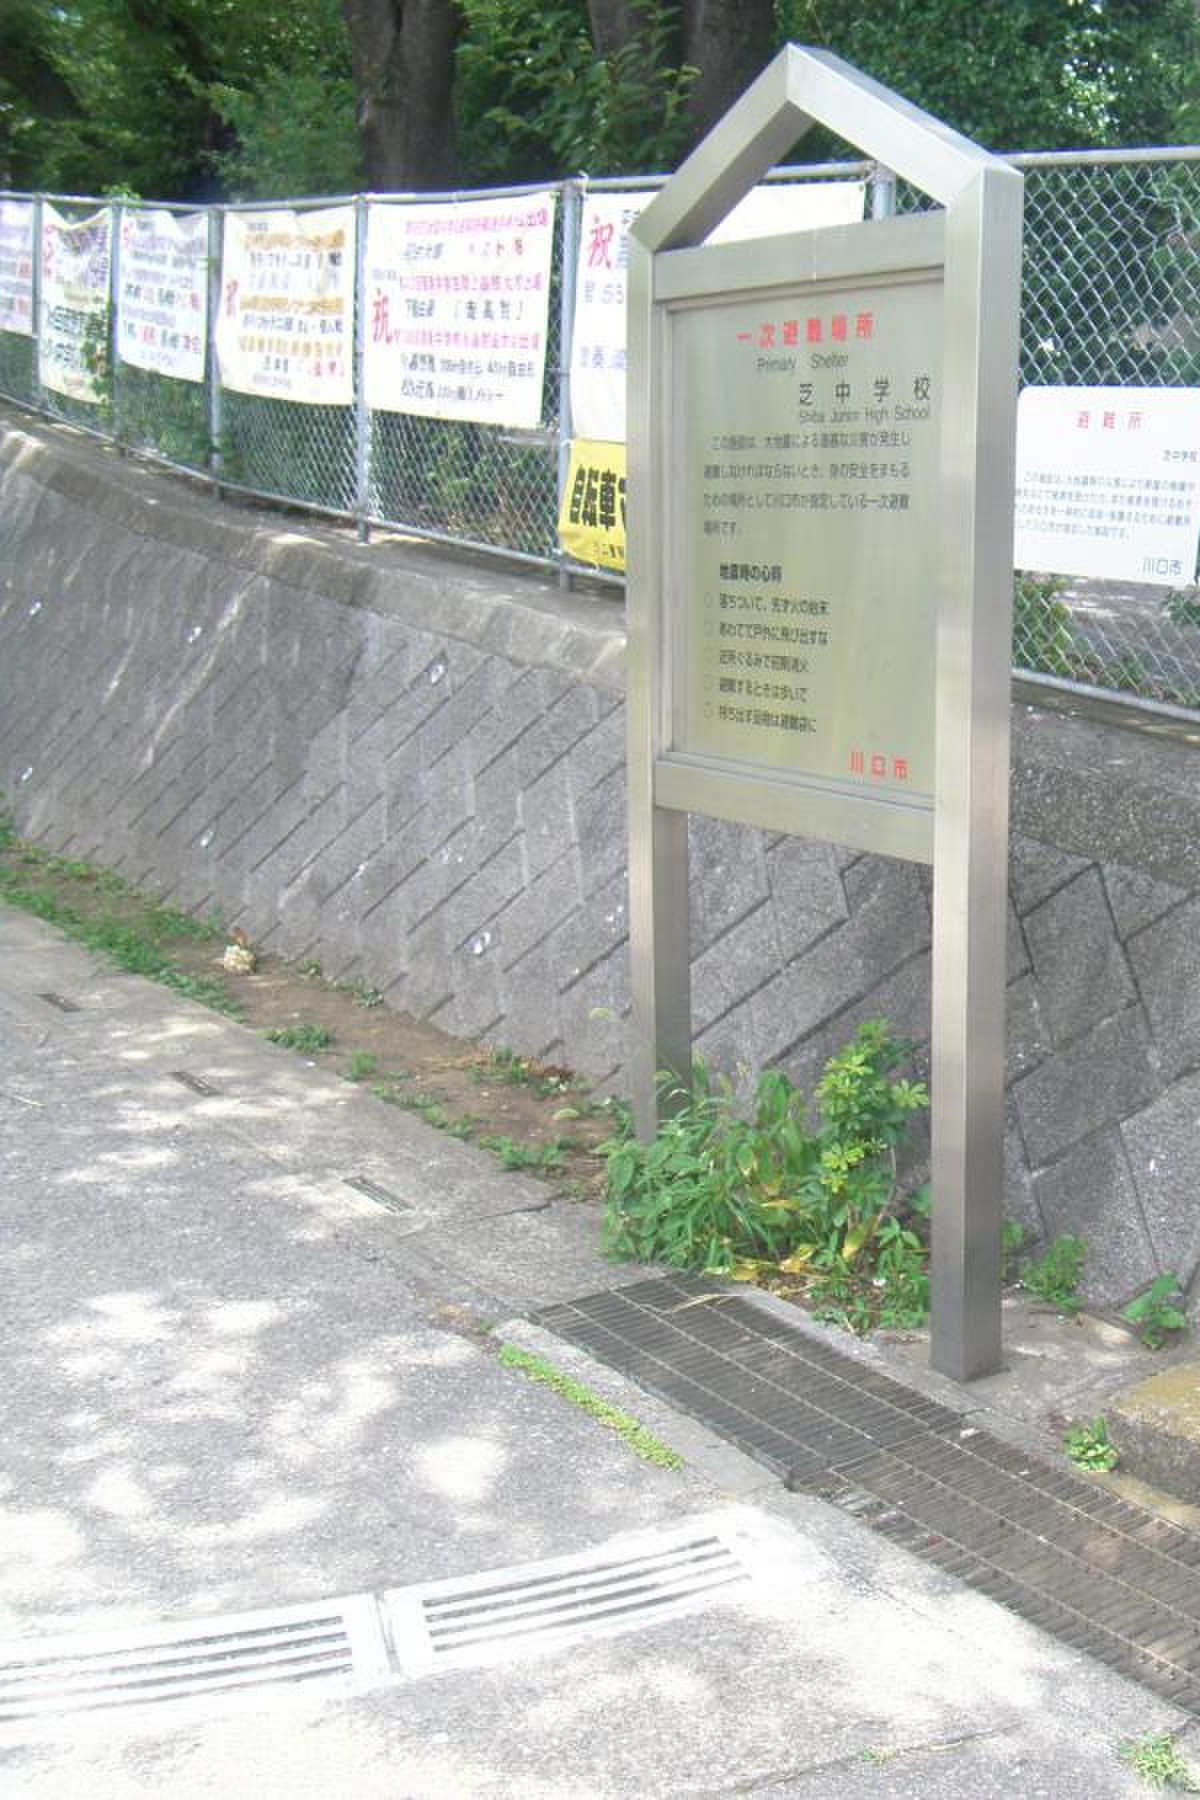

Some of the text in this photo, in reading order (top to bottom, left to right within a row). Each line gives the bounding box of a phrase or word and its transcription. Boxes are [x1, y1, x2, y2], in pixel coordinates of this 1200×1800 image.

[756, 353, 849, 376] Primary Shelter
[799, 376, 932, 406] 芝中学校
[799, 404, 931, 424] Shiba Junior High School
[1142, 557, 1183, 576] 川口市
[850, 750, 908, 780] 川口市
